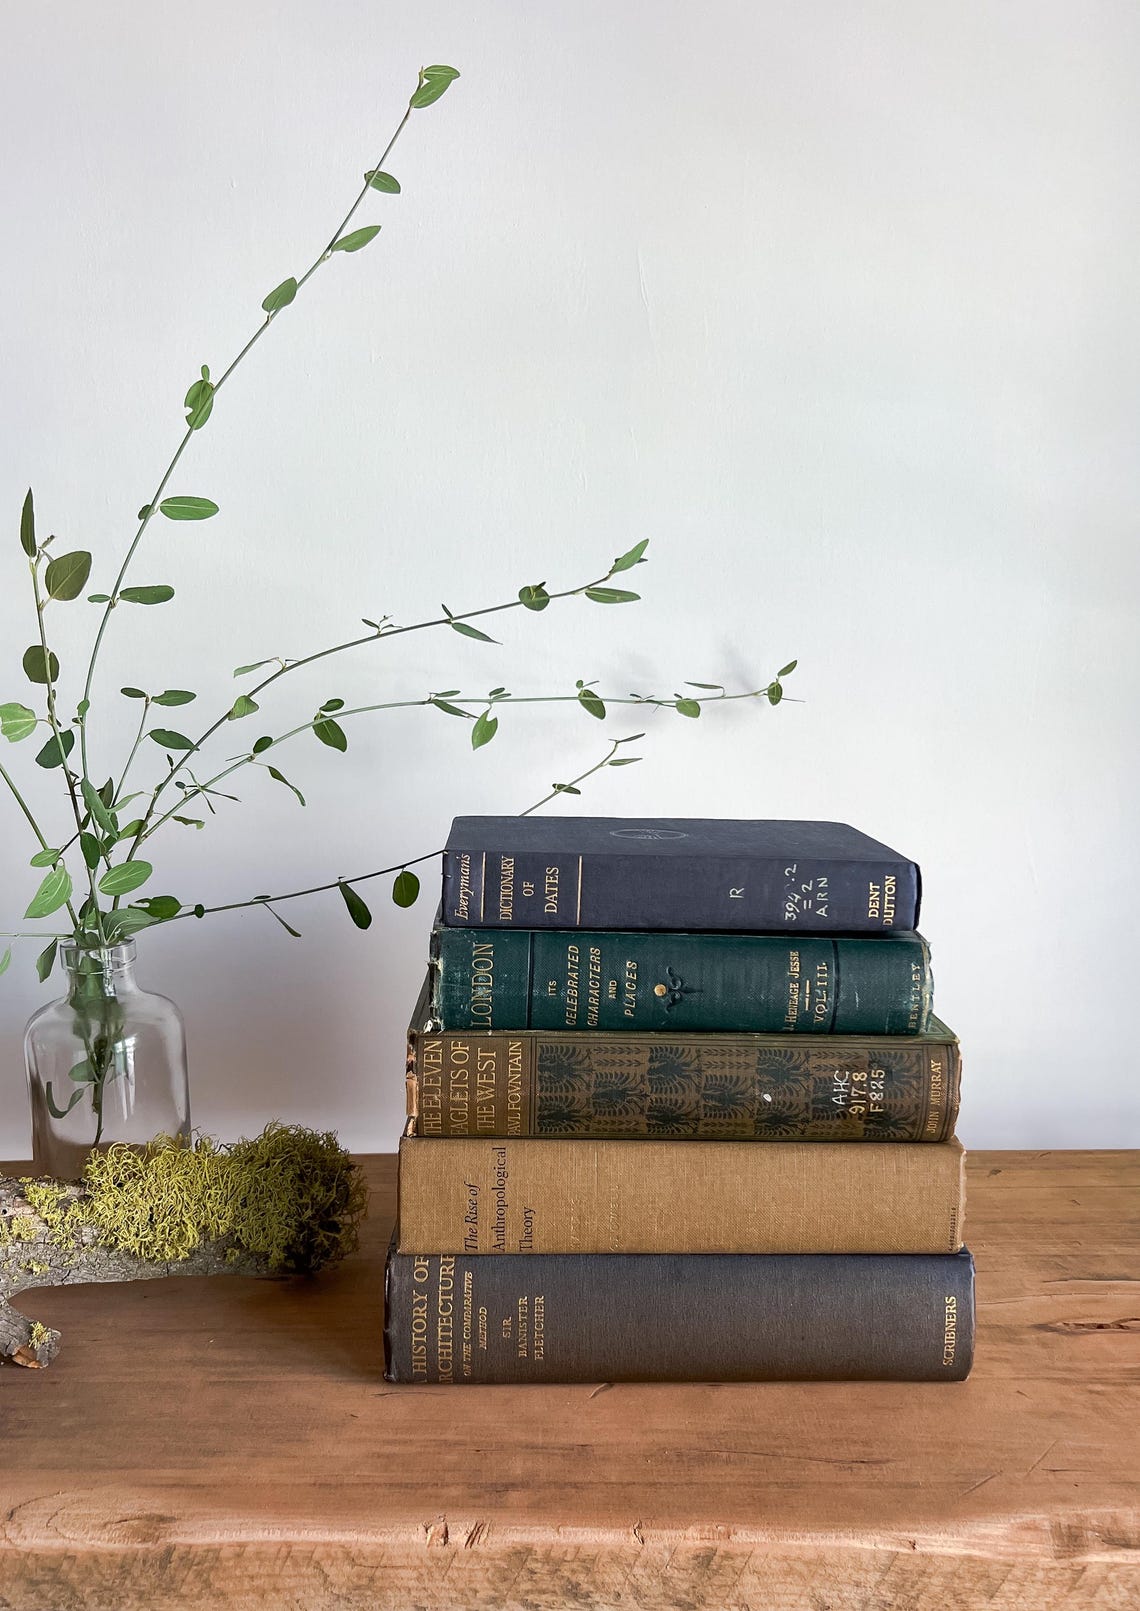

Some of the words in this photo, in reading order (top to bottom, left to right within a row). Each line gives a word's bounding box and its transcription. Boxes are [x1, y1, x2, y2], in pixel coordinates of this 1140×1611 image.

[454, 854, 474, 920] Everyman's
[500, 856, 514, 920] DICTIONARY
[523, 881, 534, 896] OF
[545, 867, 559, 913] DATES
[729, 887, 744, 898] R
[869, 882, 880, 918] DENT
[882, 876, 896, 925] DUTTON
[470, 942, 494, 1026] LONDON
[549, 981, 557, 996] ITS
[566, 946, 579, 1025] CELEBRATED
[588, 947, 601, 1026] CHARACTERS
[609, 980, 617, 999] AND
[625, 961, 637, 1016] PLACES
[422, 1040, 442, 1109] ELEVEN
[451, 1041, 469, 1064] OF
[477, 1048, 496, 1103] WEST
[849, 1071, 867, 1114] 917.8
[931, 1059, 942, 1105] MURRAY
[423, 1113, 442, 1135] THE
[450, 1070, 469, 1135] EAGLETS
[477, 1105, 495, 1130] THE
[926, 1111, 939, 1133] JOHN
[464, 1181, 480, 1196] of
[491, 1147, 508, 1252] Anthropological
[465, 1199, 477, 1225] Rise
[519, 1207, 535, 1251] Theory
[465, 1228, 478, 1251] The
[414, 1256, 429, 1283] OF
[464, 1271, 472, 1340] COMPARATIVE
[503, 1317, 511, 1338] SIR
[519, 1296, 527, 1357] BANISTER
[535, 1295, 544, 1360] FLETCHER
[412, 1290, 427, 1373] HISTORY
[463, 1343, 471, 1361] THE
[943, 1296, 957, 1366] SCRIBNERS
[464, 1365, 471, 1376] ON
